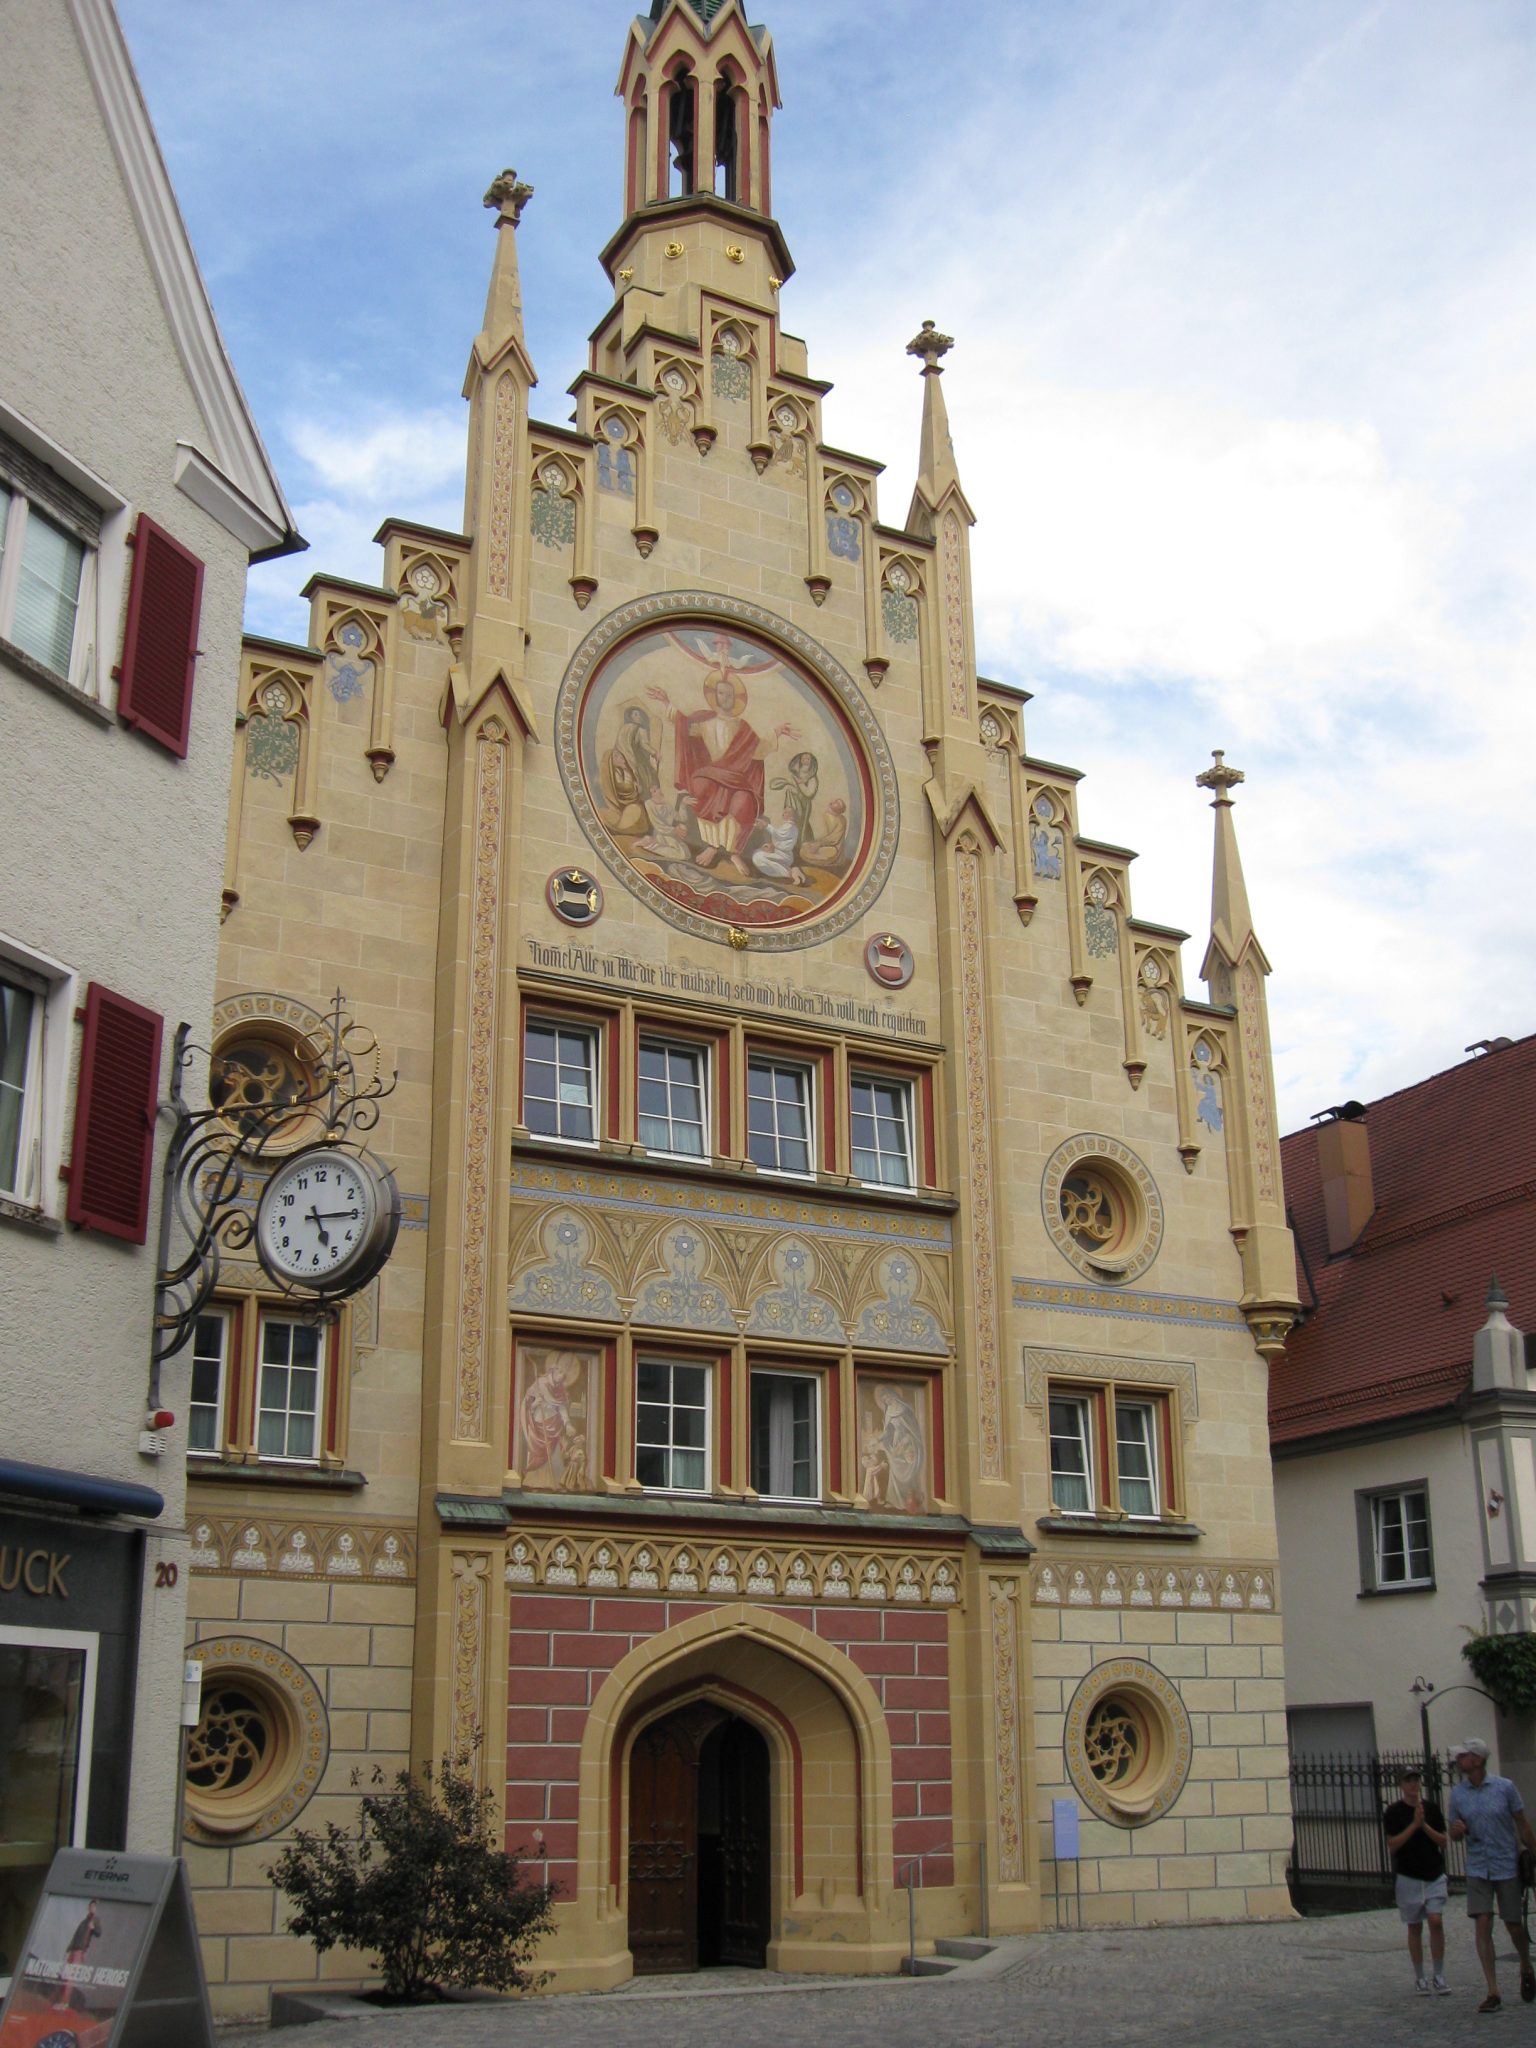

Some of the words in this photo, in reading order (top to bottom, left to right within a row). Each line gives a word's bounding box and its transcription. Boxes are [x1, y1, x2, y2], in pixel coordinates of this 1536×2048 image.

[572, 948, 599, 974] Alle
[602, 960, 615, 977] zu
[613, 956, 638, 981] Mir
[638, 962, 656, 985] die
[659, 966, 678, 988] ihr
[757, 984, 774, 1007] und
[836, 999, 855, 1021] will
[858, 1003, 880, 1028] euch
[315, 1171, 327, 1182] 12
[336, 1175, 341, 1186] 1
[298, 1178, 308, 1190] 11
[282, 1194, 295, 1206] 10
[347, 1188, 354, 1200] 2
[279, 1216, 286, 1227] 9
[282, 1236, 289, 1247] 8
[345, 1230, 352, 1241] 4
[295, 1250, 302, 1261] 7
[331, 1246, 338, 1258] 5
[312, 1253, 319, 1265] 6
[0, 1546, 70, 1597] UCK
[155, 1561, 178, 1588] 20
[84, 1870, 129, 1882] ETERNA
